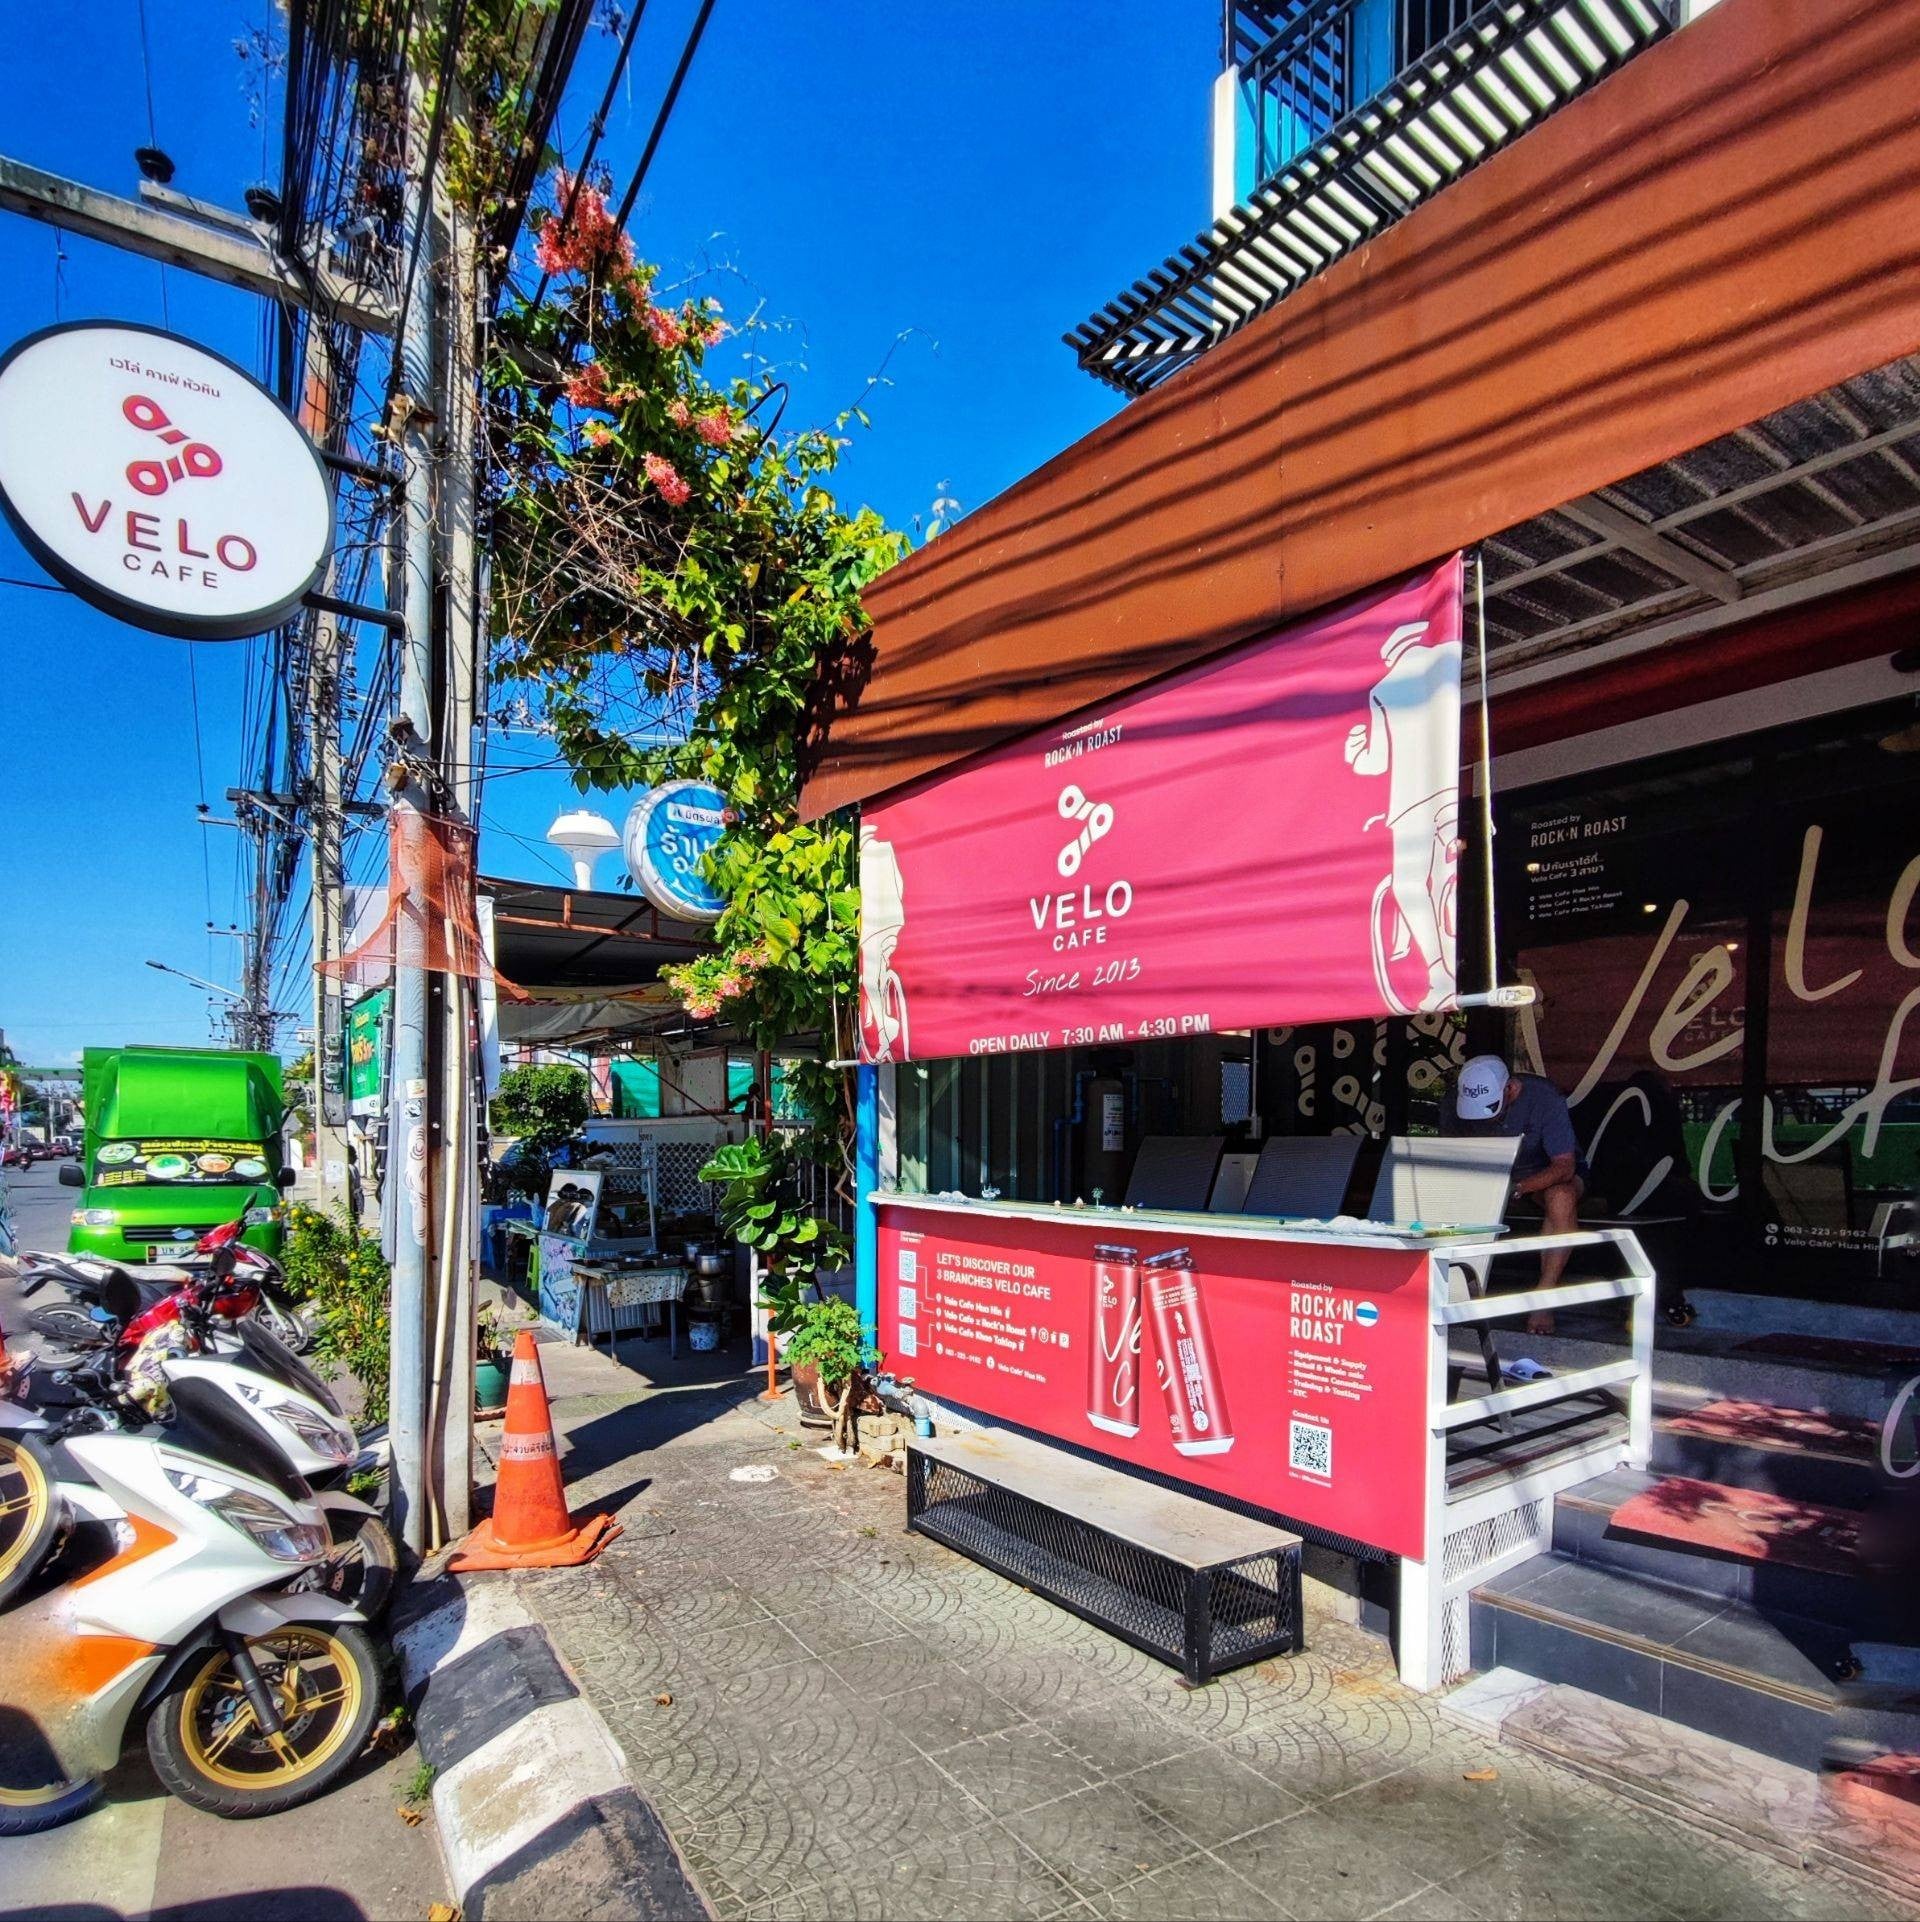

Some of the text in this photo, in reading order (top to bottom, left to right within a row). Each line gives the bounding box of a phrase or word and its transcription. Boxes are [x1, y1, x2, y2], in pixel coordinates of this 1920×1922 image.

[183, 377, 221, 398] หัวหิน
[72, 491, 257, 571] VELO
[122, 553, 219, 588] CAFE
[1062, 718, 1104, 740] Roasted by
[1087, 725, 1123, 752] ROAST
[1531, 814, 1581, 830] Roasted by
[1584, 816, 1627, 837] ROAST
[1570, 868, 1577, 878] 3
[1030, 880, 1133, 930] VELO
[1053, 926, 1106, 951] CAFE
[1023, 957, 1142, 996] Since 2013
[970, 1036, 1006, 1055] OPEN
[1010, 1031, 1050, 1050] DAILY
[1062, 1025, 1094, 1046] 7:30
[1099, 1023, 1124, 1041] AM
[1138, 1018, 1176, 1038] 4:30
[1181, 1014, 1210, 1033] PM
[936, 1252, 1035, 1279] LET'S DISCOVER OUR
[936, 1269, 1051, 1300] 3 BRANCHES VELO CAFE
[1291, 1280, 1333, 1294] Roasted by
[1290, 1316, 1344, 1345] ROAST
